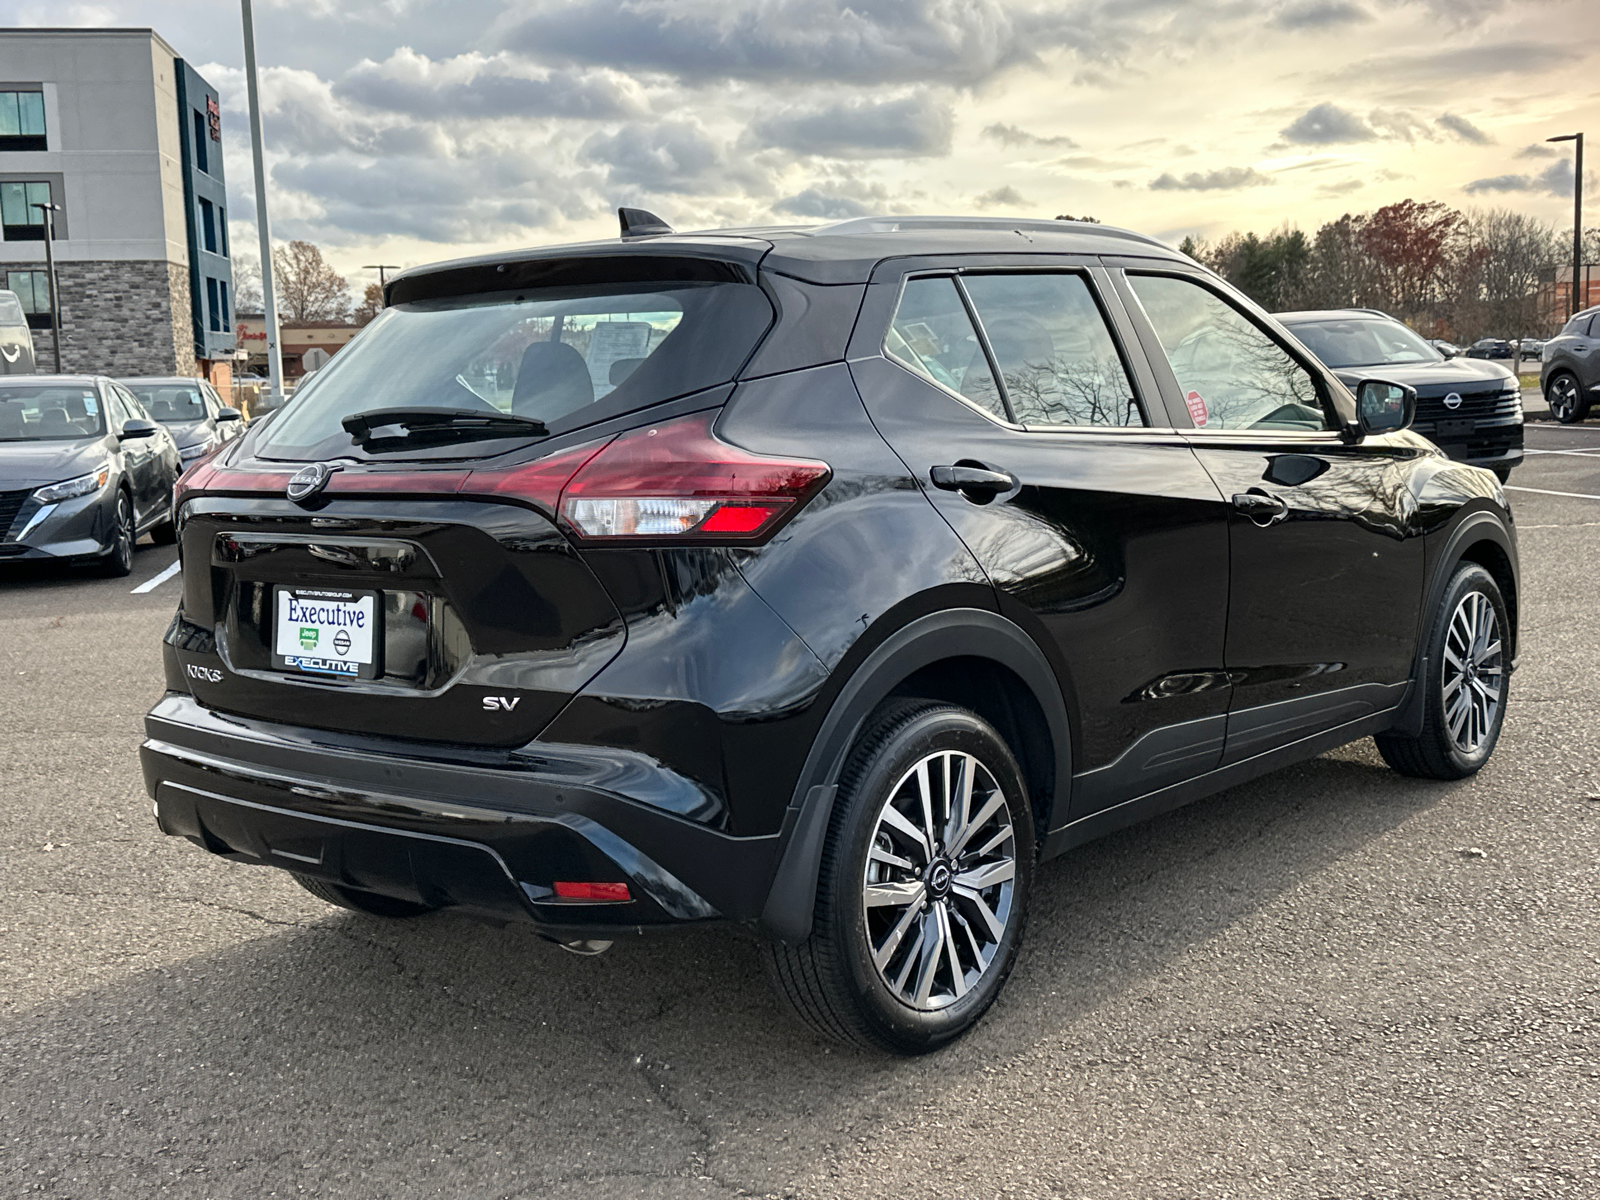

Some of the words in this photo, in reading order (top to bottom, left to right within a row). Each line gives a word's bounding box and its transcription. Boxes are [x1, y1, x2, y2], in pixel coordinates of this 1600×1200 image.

[287, 598, 365, 628] Executive
[301, 629, 317, 638] Jeep
[186, 663, 224, 683] KICKS
[285, 656, 359, 674] EXECUTIVE
[482, 696, 521, 711] SV
